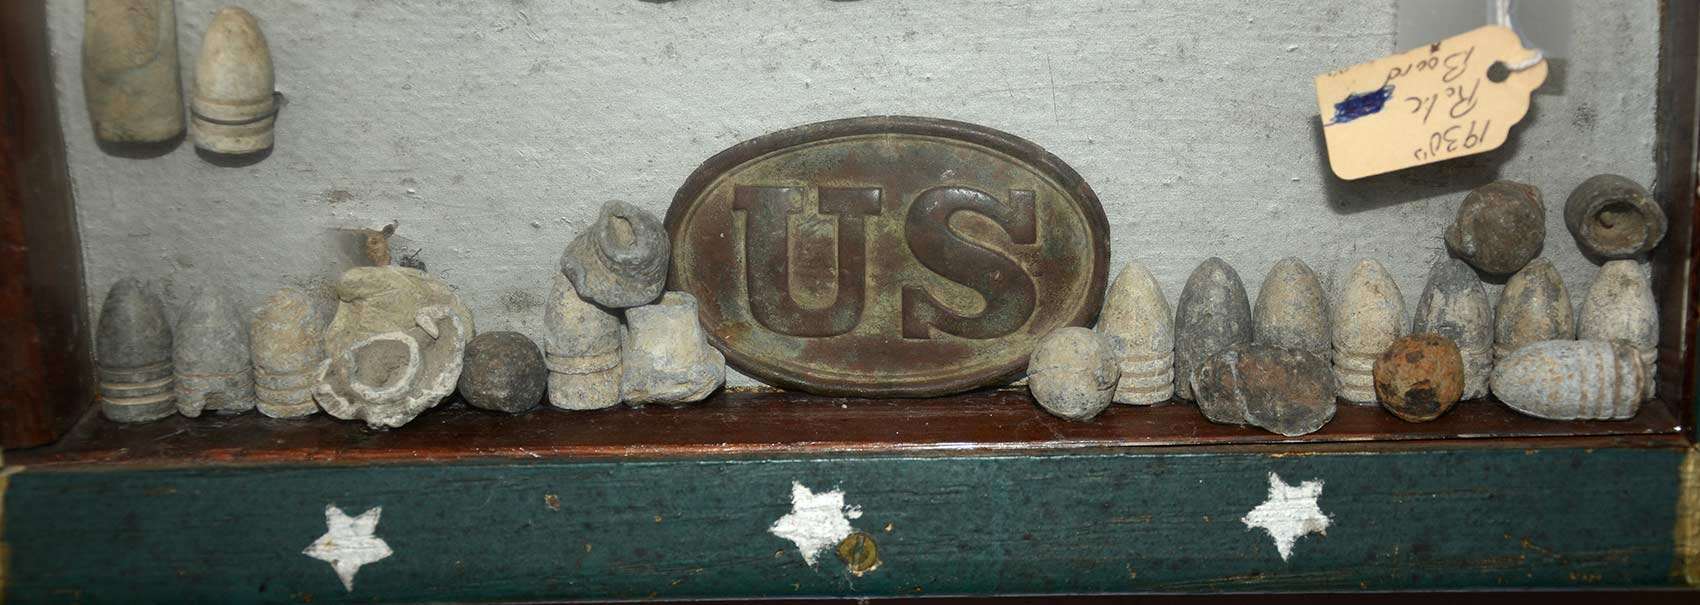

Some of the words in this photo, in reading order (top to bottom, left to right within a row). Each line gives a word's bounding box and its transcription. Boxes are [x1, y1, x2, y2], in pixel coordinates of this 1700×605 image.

[1381, 46, 1475, 89] Board
[1405, 78, 1481, 123] Relic
[1414, 119, 1491, 161] 1930's
[733, 185, 1038, 340] US
